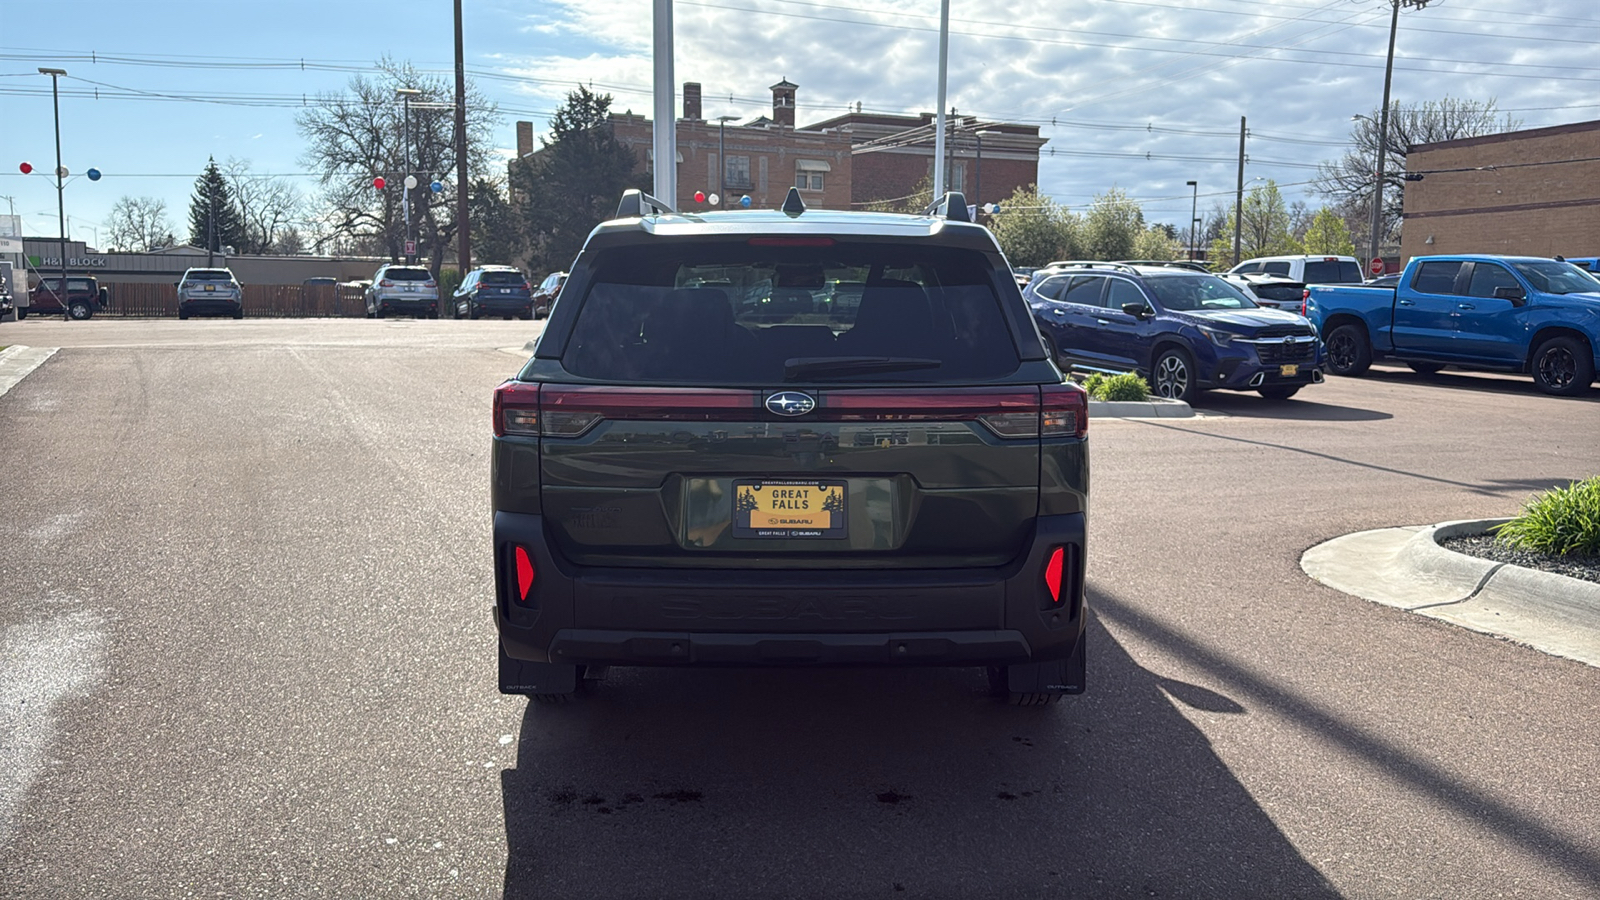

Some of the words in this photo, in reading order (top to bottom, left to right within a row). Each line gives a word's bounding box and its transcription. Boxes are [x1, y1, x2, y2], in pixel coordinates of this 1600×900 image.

[69, 257, 105, 267] BLOCK
[772, 489, 810, 499] GREAT
[772, 499, 809, 510] FALLS
